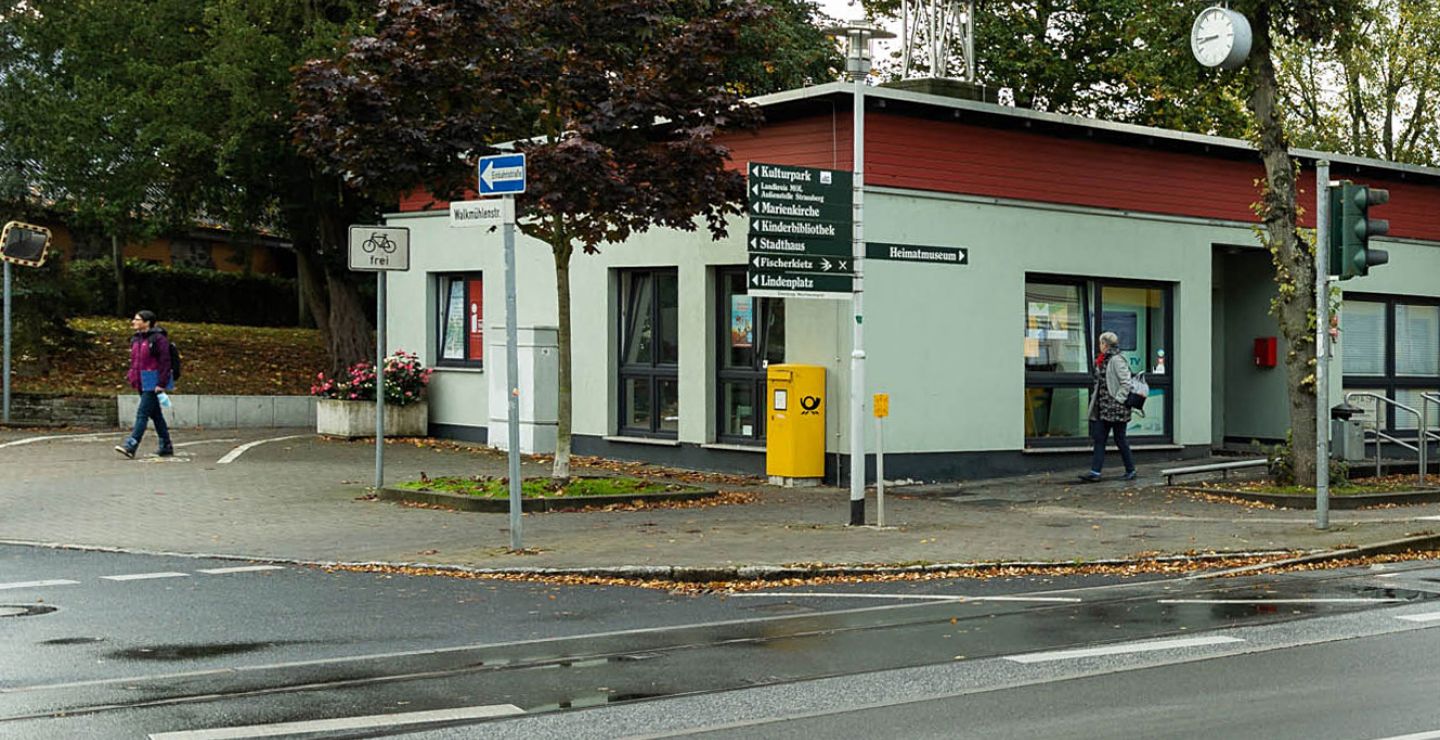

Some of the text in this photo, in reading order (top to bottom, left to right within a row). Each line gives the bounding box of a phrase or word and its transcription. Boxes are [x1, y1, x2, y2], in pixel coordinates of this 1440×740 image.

[761, 165, 812, 183] Kulturpark
[761, 201, 820, 217] Marienkirche
[761, 219, 836, 236] Kinderbibliothek
[759, 237, 806, 251] Stadthaus
[369, 255, 390, 266] frei
[889, 246, 957, 261] Heimatmuseum
[760, 257, 814, 269] Fischerkietz
[760, 274, 814, 289] Lindenplatz
